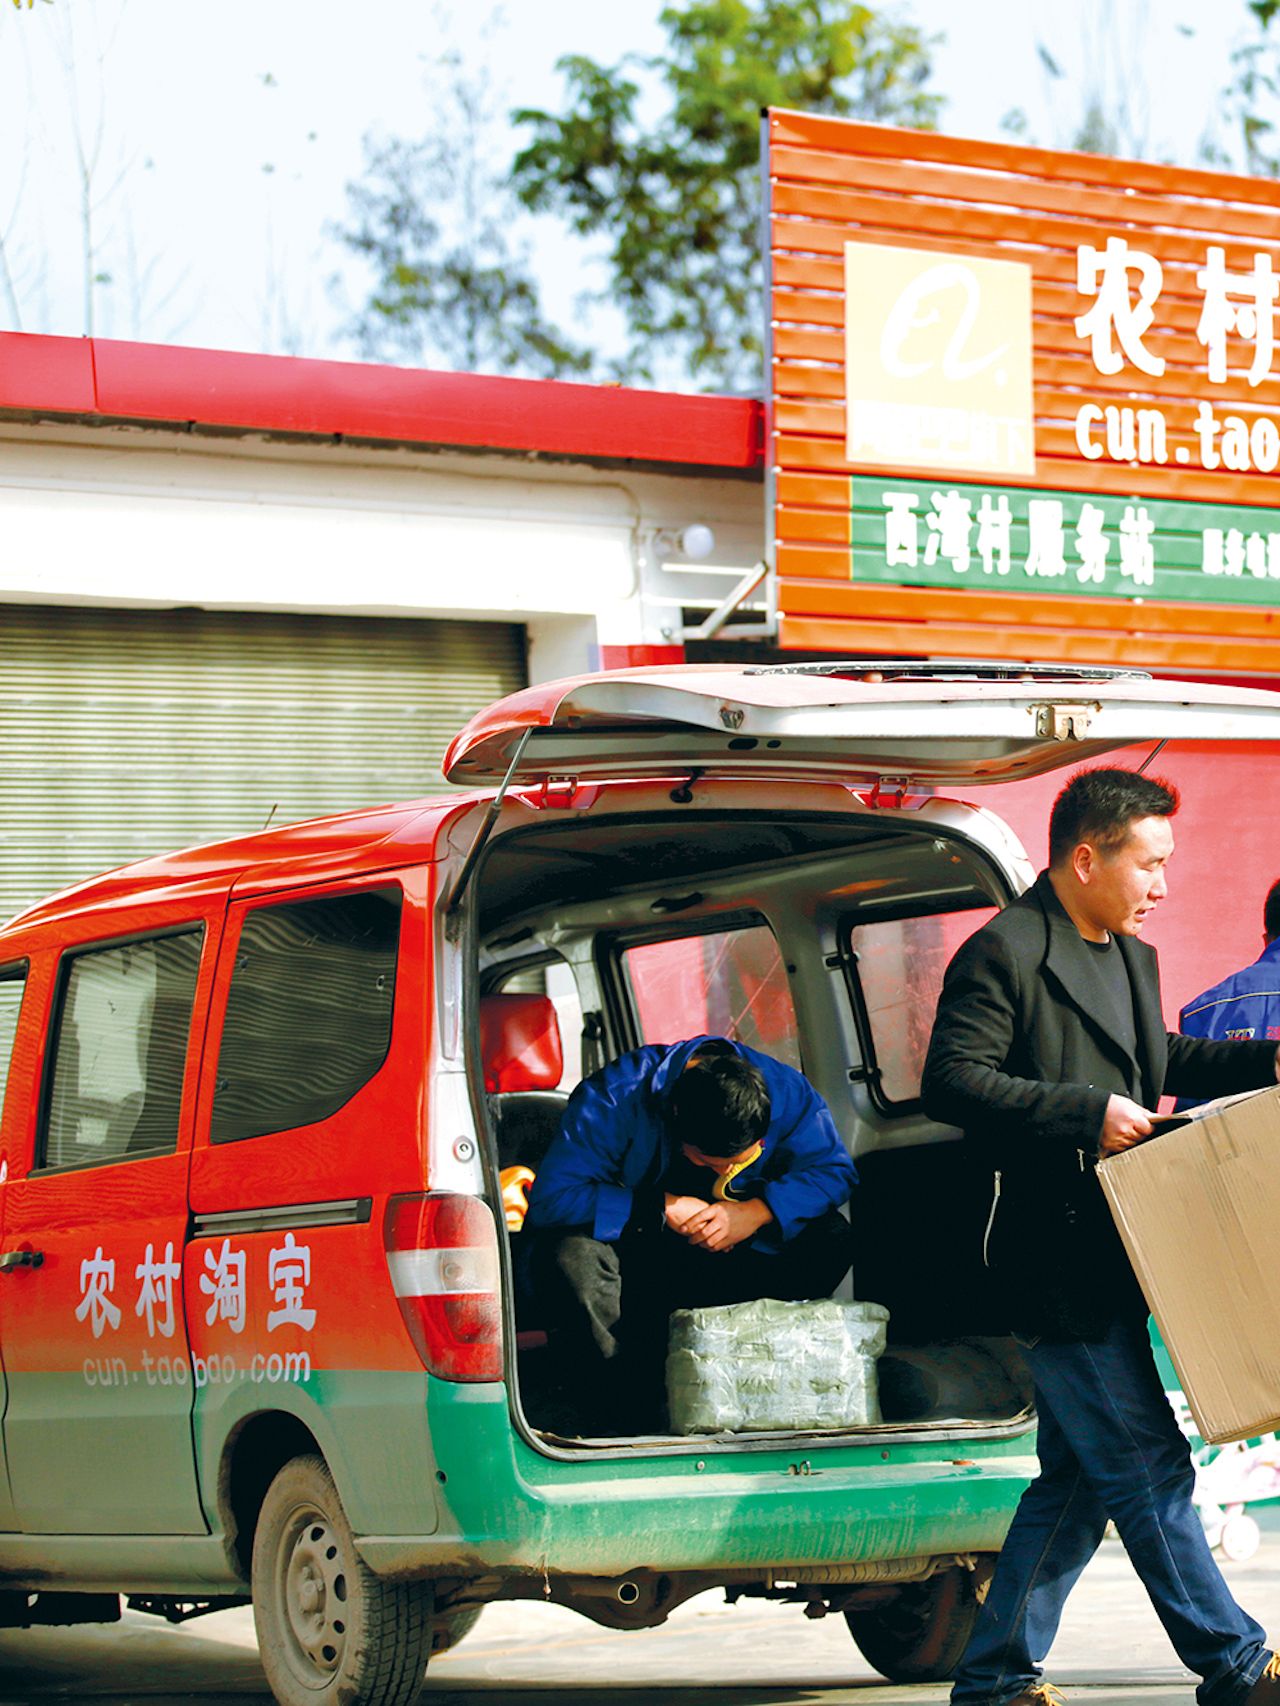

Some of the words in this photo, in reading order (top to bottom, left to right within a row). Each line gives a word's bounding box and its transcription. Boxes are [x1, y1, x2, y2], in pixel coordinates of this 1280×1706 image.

[75, 1232, 317, 1339] 农村淘宝
[83, 1350, 311, 1388] cun.taobao.com
